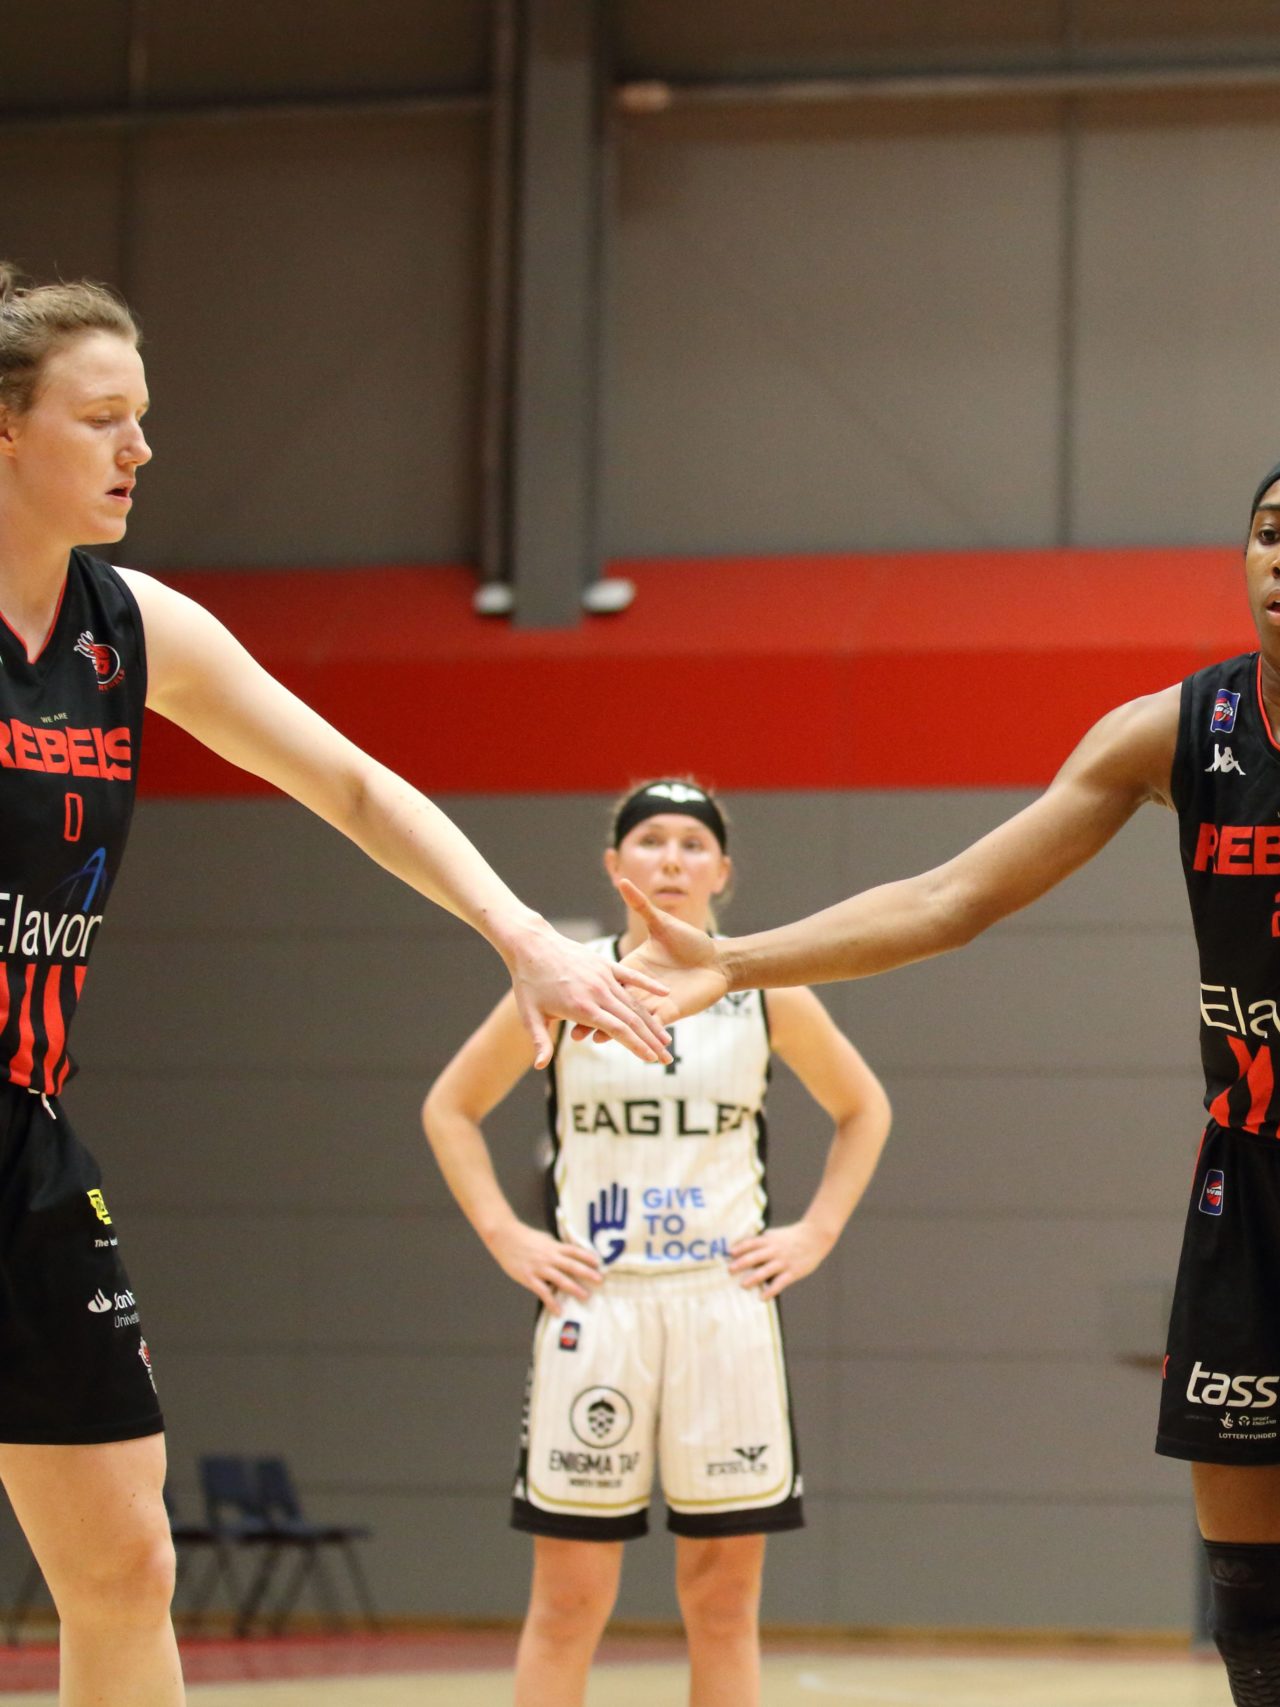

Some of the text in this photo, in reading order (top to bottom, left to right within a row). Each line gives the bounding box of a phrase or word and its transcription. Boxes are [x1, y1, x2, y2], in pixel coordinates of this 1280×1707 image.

[41, 712, 69, 724] WE ARE
[642, 1187, 705, 1208] GIVE
[643, 1214, 685, 1236] TO
[645, 1237, 732, 1260] LOCAL
[1186, 1361, 1280, 1408] tass
[1219, 1432, 1277, 1440] LOTTERY FUNDED
[549, 1450, 613, 1475] ENIGMA
